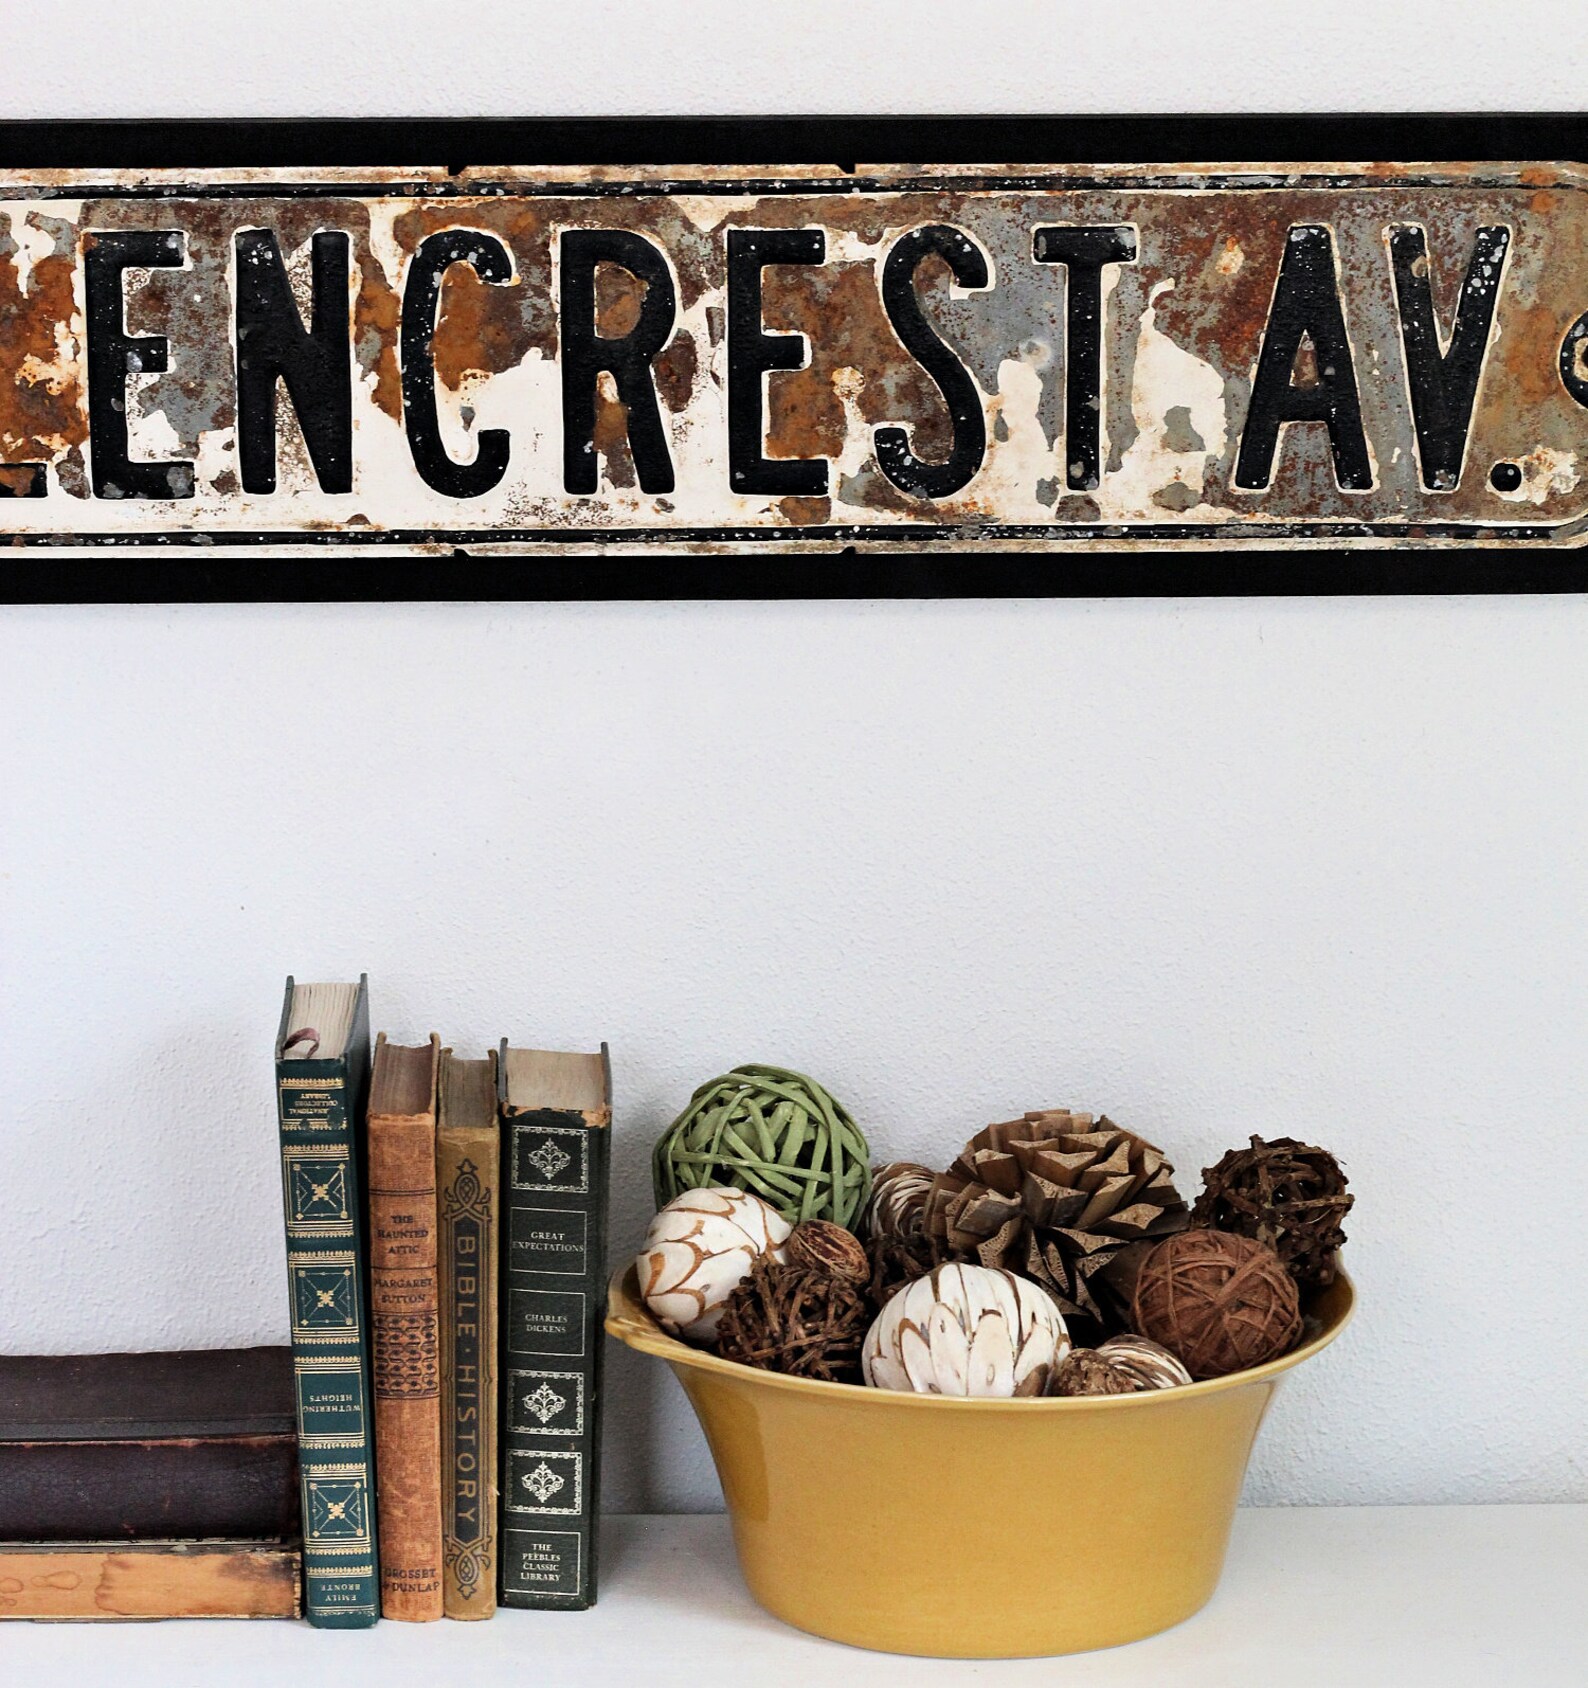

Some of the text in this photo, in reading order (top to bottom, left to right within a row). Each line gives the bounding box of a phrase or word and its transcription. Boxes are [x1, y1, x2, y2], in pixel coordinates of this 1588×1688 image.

[0, 224, 1522, 499] ENCREST AV.
[391, 1215, 414, 1223] THE
[377, 1229, 429, 1239] HAUNTED
[530, 1231, 566, 1241] GREAT
[388, 1245, 420, 1254] ATTIC
[512, 1241, 584, 1253] EXPECTATIONS
[374, 1278, 433, 1288] MARGARET
[457, 1236, 476, 1337] BIBLE
[525, 1313, 568, 1324] CHARLES
[526, 1324, 567, 1333] DICKENS
[309, 1394, 353, 1402] HEIGHTS
[302, 1404, 361, 1413] WUTHERING
[457, 1364, 477, 1522] HISTORY
[532, 1543, 552, 1551] THE
[522, 1553, 561, 1562] PEEBLES
[522, 1562, 560, 1571] CLASSIC
[385, 1568, 436, 1579] GROSSET
[520, 1572, 561, 1581] LIBRARY
[392, 1581, 440, 1592] DUNLAP
[325, 1594, 357, 1602] EMILY
